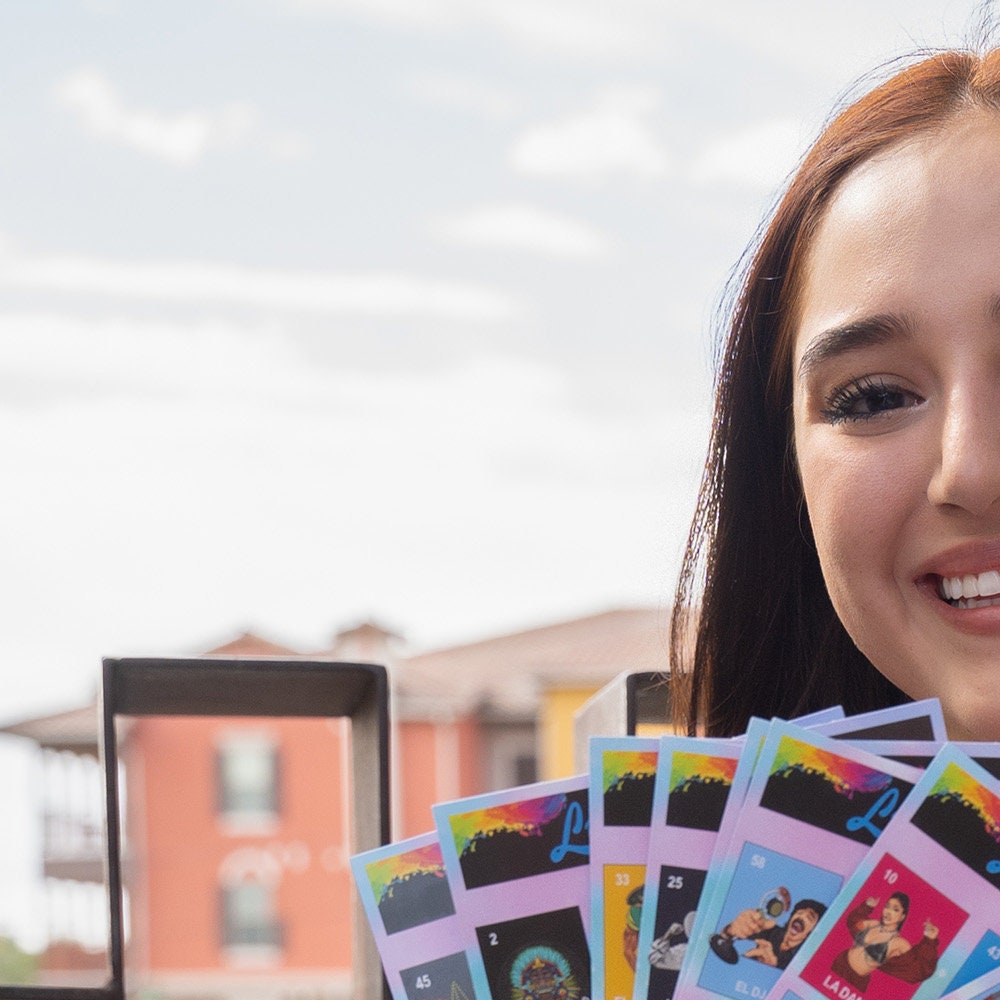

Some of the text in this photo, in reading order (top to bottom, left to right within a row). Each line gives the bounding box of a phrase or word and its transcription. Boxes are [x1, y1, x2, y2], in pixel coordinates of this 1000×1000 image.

[615, 873, 630, 887] 33
[667, 876, 684, 889] 25
[883, 868, 899, 885] 10
[489, 932, 499, 946] 2
[415, 974, 431, 989] 45
[823, 974, 839, 993] LA
